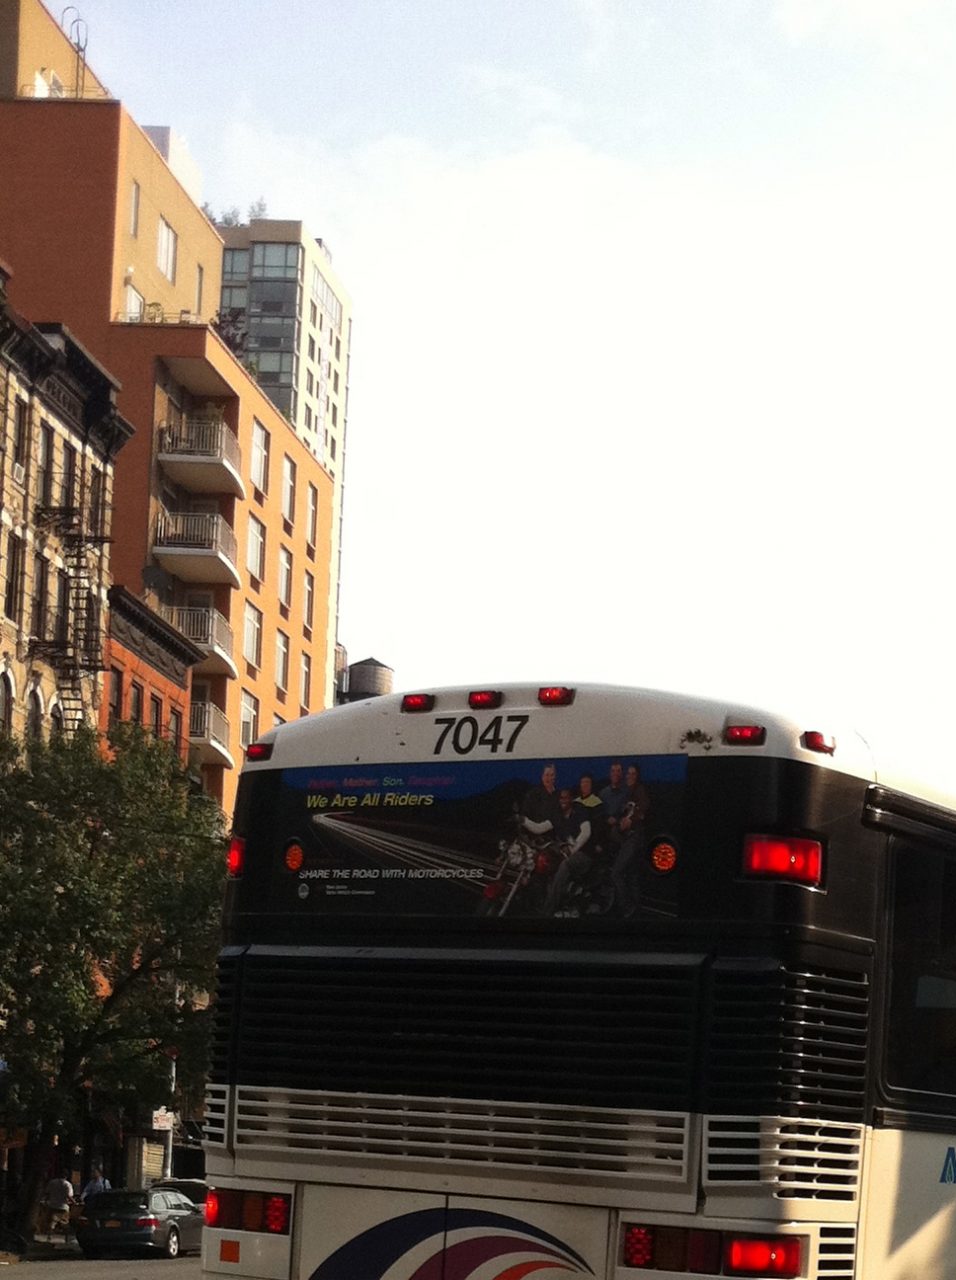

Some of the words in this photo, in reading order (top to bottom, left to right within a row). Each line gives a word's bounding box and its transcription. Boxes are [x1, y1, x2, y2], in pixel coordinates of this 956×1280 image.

[433, 715, 529, 755] 7047
[306, 796, 327, 809] We
[331, 794, 358, 808] Are
[361, 793, 379, 806] All
[384, 793, 434, 806] Riders
[299, 869, 330, 879] SHARE
[332, 869, 350, 878] THE
[352, 869, 380, 878] ROAD
[382, 868, 406, 878] WITH
[408, 868, 484, 878] MOTORCYCLES
